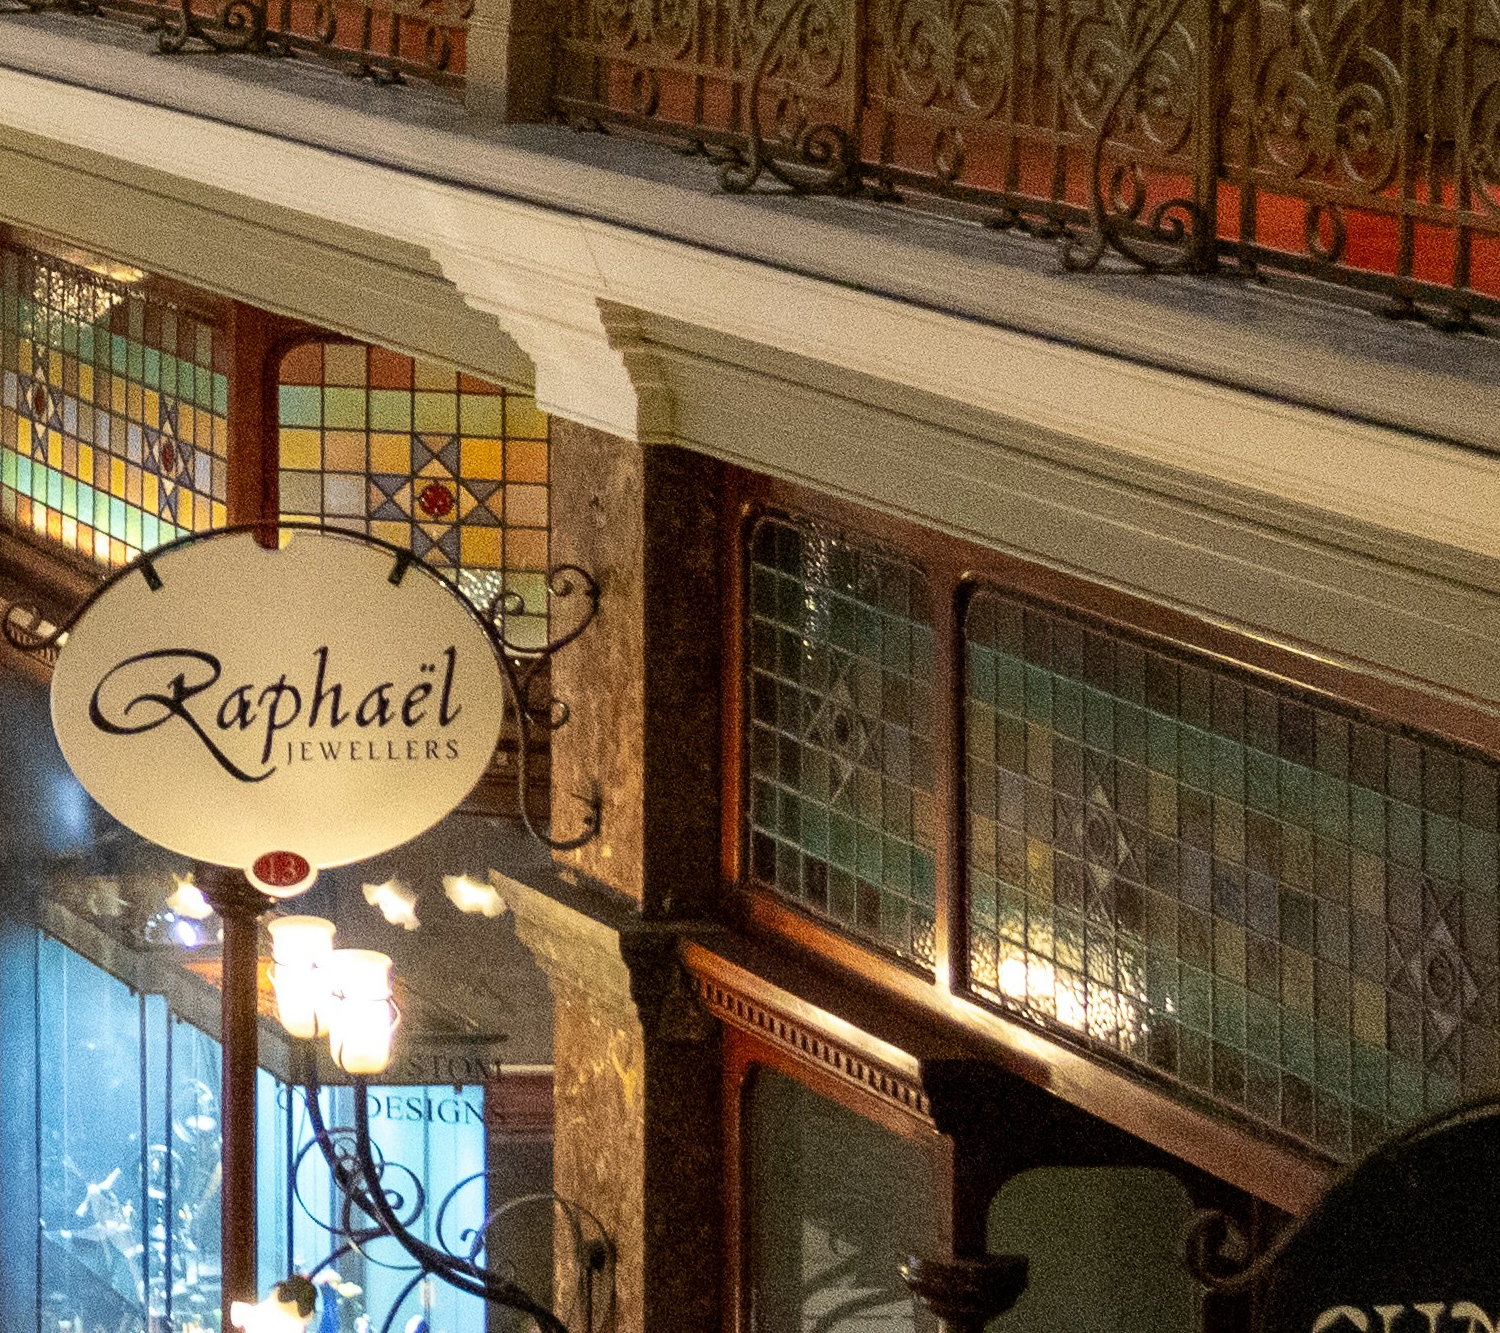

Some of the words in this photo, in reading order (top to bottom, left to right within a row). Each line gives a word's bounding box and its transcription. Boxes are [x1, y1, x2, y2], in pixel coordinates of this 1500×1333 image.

[88, 645, 462, 783] Raphaël
[286, 739, 461, 765] JEWELLERS
[269, 856, 296, 882] 13
